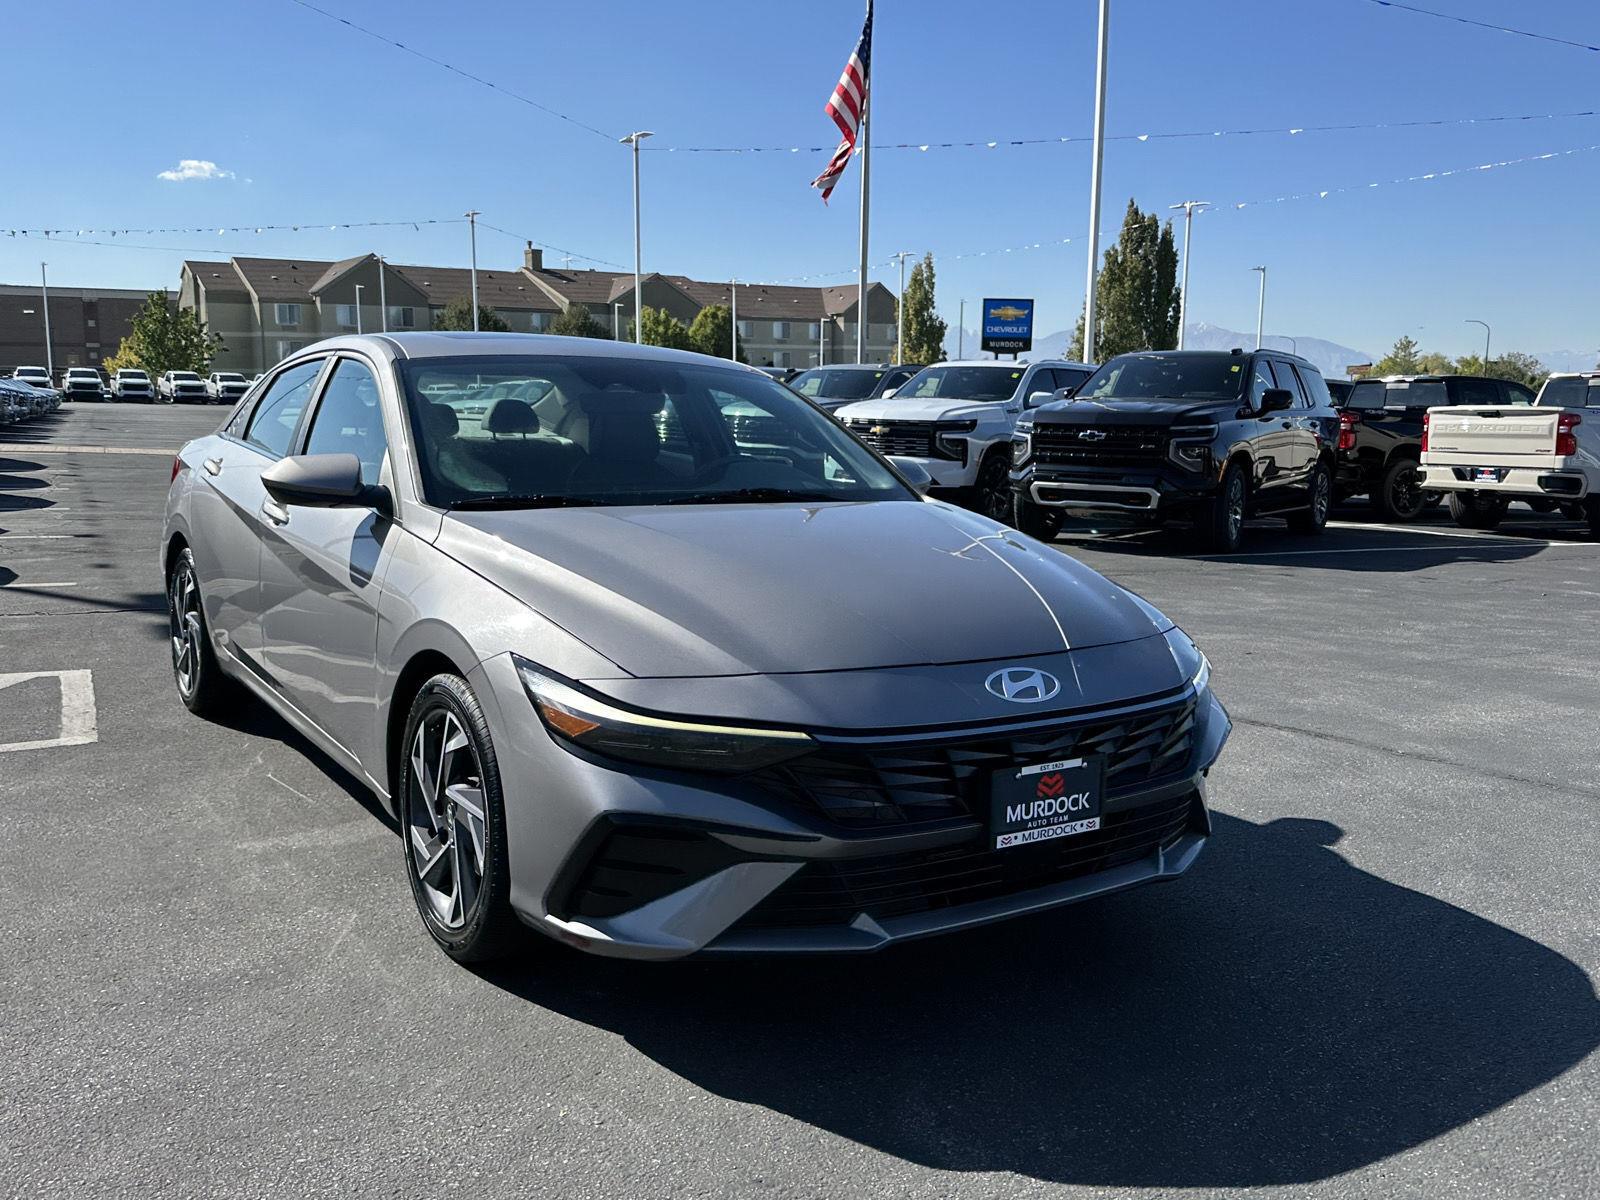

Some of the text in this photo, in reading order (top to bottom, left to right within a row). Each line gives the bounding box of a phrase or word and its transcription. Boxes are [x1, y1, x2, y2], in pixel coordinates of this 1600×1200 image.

[1006, 792, 1090, 823] MURDOCK
[1027, 814, 1069, 828] AUTO TEAM
[1022, 823, 1078, 842] MURDOCK
